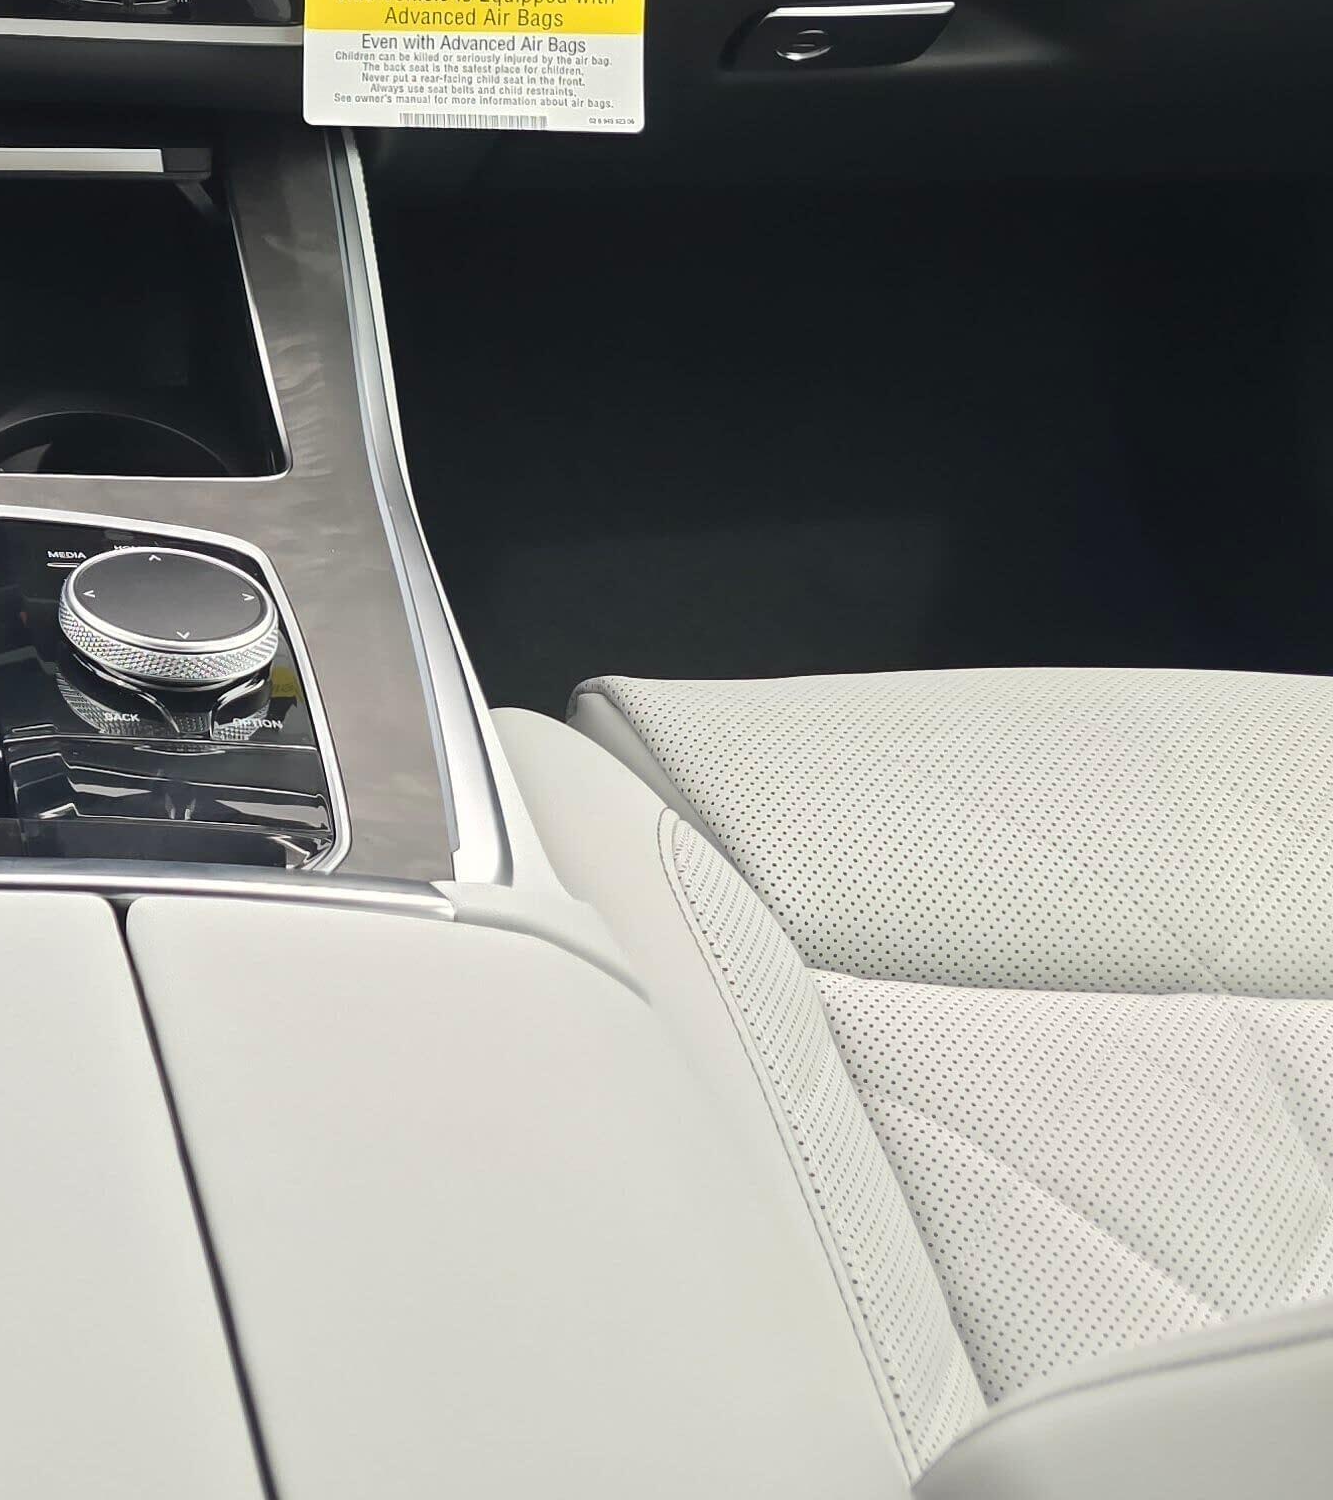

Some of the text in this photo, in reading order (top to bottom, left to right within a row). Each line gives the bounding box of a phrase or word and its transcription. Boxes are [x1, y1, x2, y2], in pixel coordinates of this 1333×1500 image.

[384, 7, 564, 31] Advanced Air Bags
[362, 33, 587, 56] Even with Advanced Air Bags
[335, 51, 375, 61] Children
[378, 53, 396, 61] can
[399, 51, 410, 61] be
[414, 52, 440, 62] killed
[456, 54, 501, 64] seriously
[504, 54, 538, 65] injured
[542, 55, 554, 66] by
[557, 56, 572, 65] the
[575, 56, 588, 65] air
[591, 56, 612, 67] bag.
[362, 62, 380, 71] The
[383, 62, 406, 72] back
[409, 63, 429, 72] seat
[433, 63, 440, 72] is
[444, 63, 459, 72] the
[462, 64, 491, 73] safest
[495, 65, 520, 75] place
[524, 65, 538, 74] for
[362, 73, 389, 82] Never
[393, 73, 408, 83] put
[420, 74, 473, 85] rear-facing
[476, 75, 500, 84] child
[503, 76, 523, 85] seat
[527, 76, 536, 85] in
[539, 76, 555, 85] the
[558, 77, 585, 86] front.
[370, 83, 577, 97] Always use seat belts and child restraints.
[334, 93, 614, 109] See owner's manual for more information about air bags.
[47, 550, 87, 559] MEDIA
[103, 712, 140, 722] BACK
[232, 716, 284, 729] OPTION
